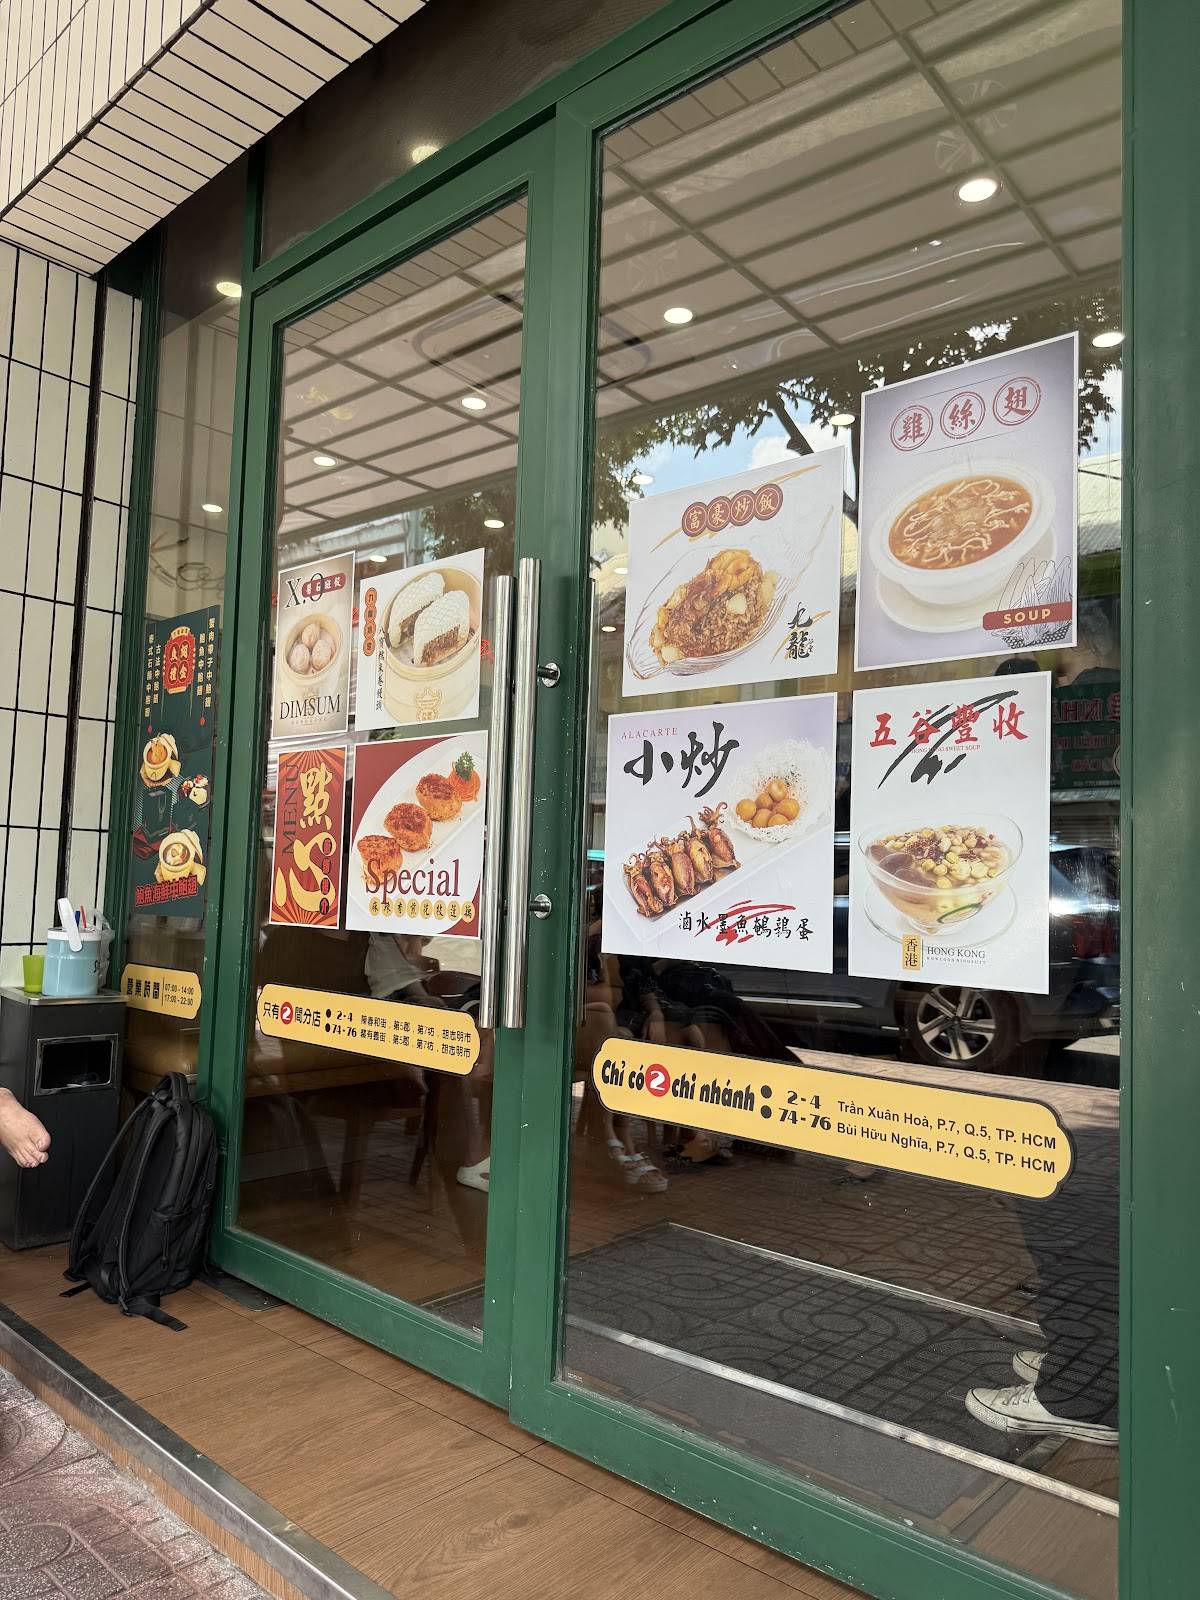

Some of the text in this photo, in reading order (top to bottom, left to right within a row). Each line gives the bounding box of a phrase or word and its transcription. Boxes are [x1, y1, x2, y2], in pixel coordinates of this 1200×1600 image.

[898, 385, 1032, 442] 雞絲翅
[689, 493, 778, 530] 富豪炒飯
[1003, 607, 1051, 625] SOUP
[279, 694, 341, 720] DIMSUM
[870, 701, 1029, 747] 五谷豐收
[621, 727, 678, 741] ALACARTE
[623, 720, 740, 798] 小炒
[282, 761, 300, 857] MENU
[366, 858, 460, 905] Special
[905, 938, 918, 968] 香港
[927, 947, 986, 959] HONG KONG
[127, 977, 161, 1000] 營業時間
[601, 1059, 756, 1111] Chỉ có 2 chi nhánh
[837, 1100, 864, 1116] Trần
[867, 1106, 900, 1122] Xuân
[904, 1112, 933, 1130] Hoà,
[937, 1118, 960, 1135] P.7,
[964, 1123, 991, 1140] Q.5,
[995, 1128, 1017, 1143] TP.
[1021, 1132, 1056, 1149] HCM
[837, 1122, 857, 1136] Bùi
[861, 1126, 887, 1142] Hữu
[891, 1131, 932, 1152] Nghĩa,
[936, 1141, 959, 1157] P.7,
[963, 1146, 991, 1163] Q.5,
[994, 1151, 1016, 1166] TP.
[1020, 1156, 1055, 1173] HCM
